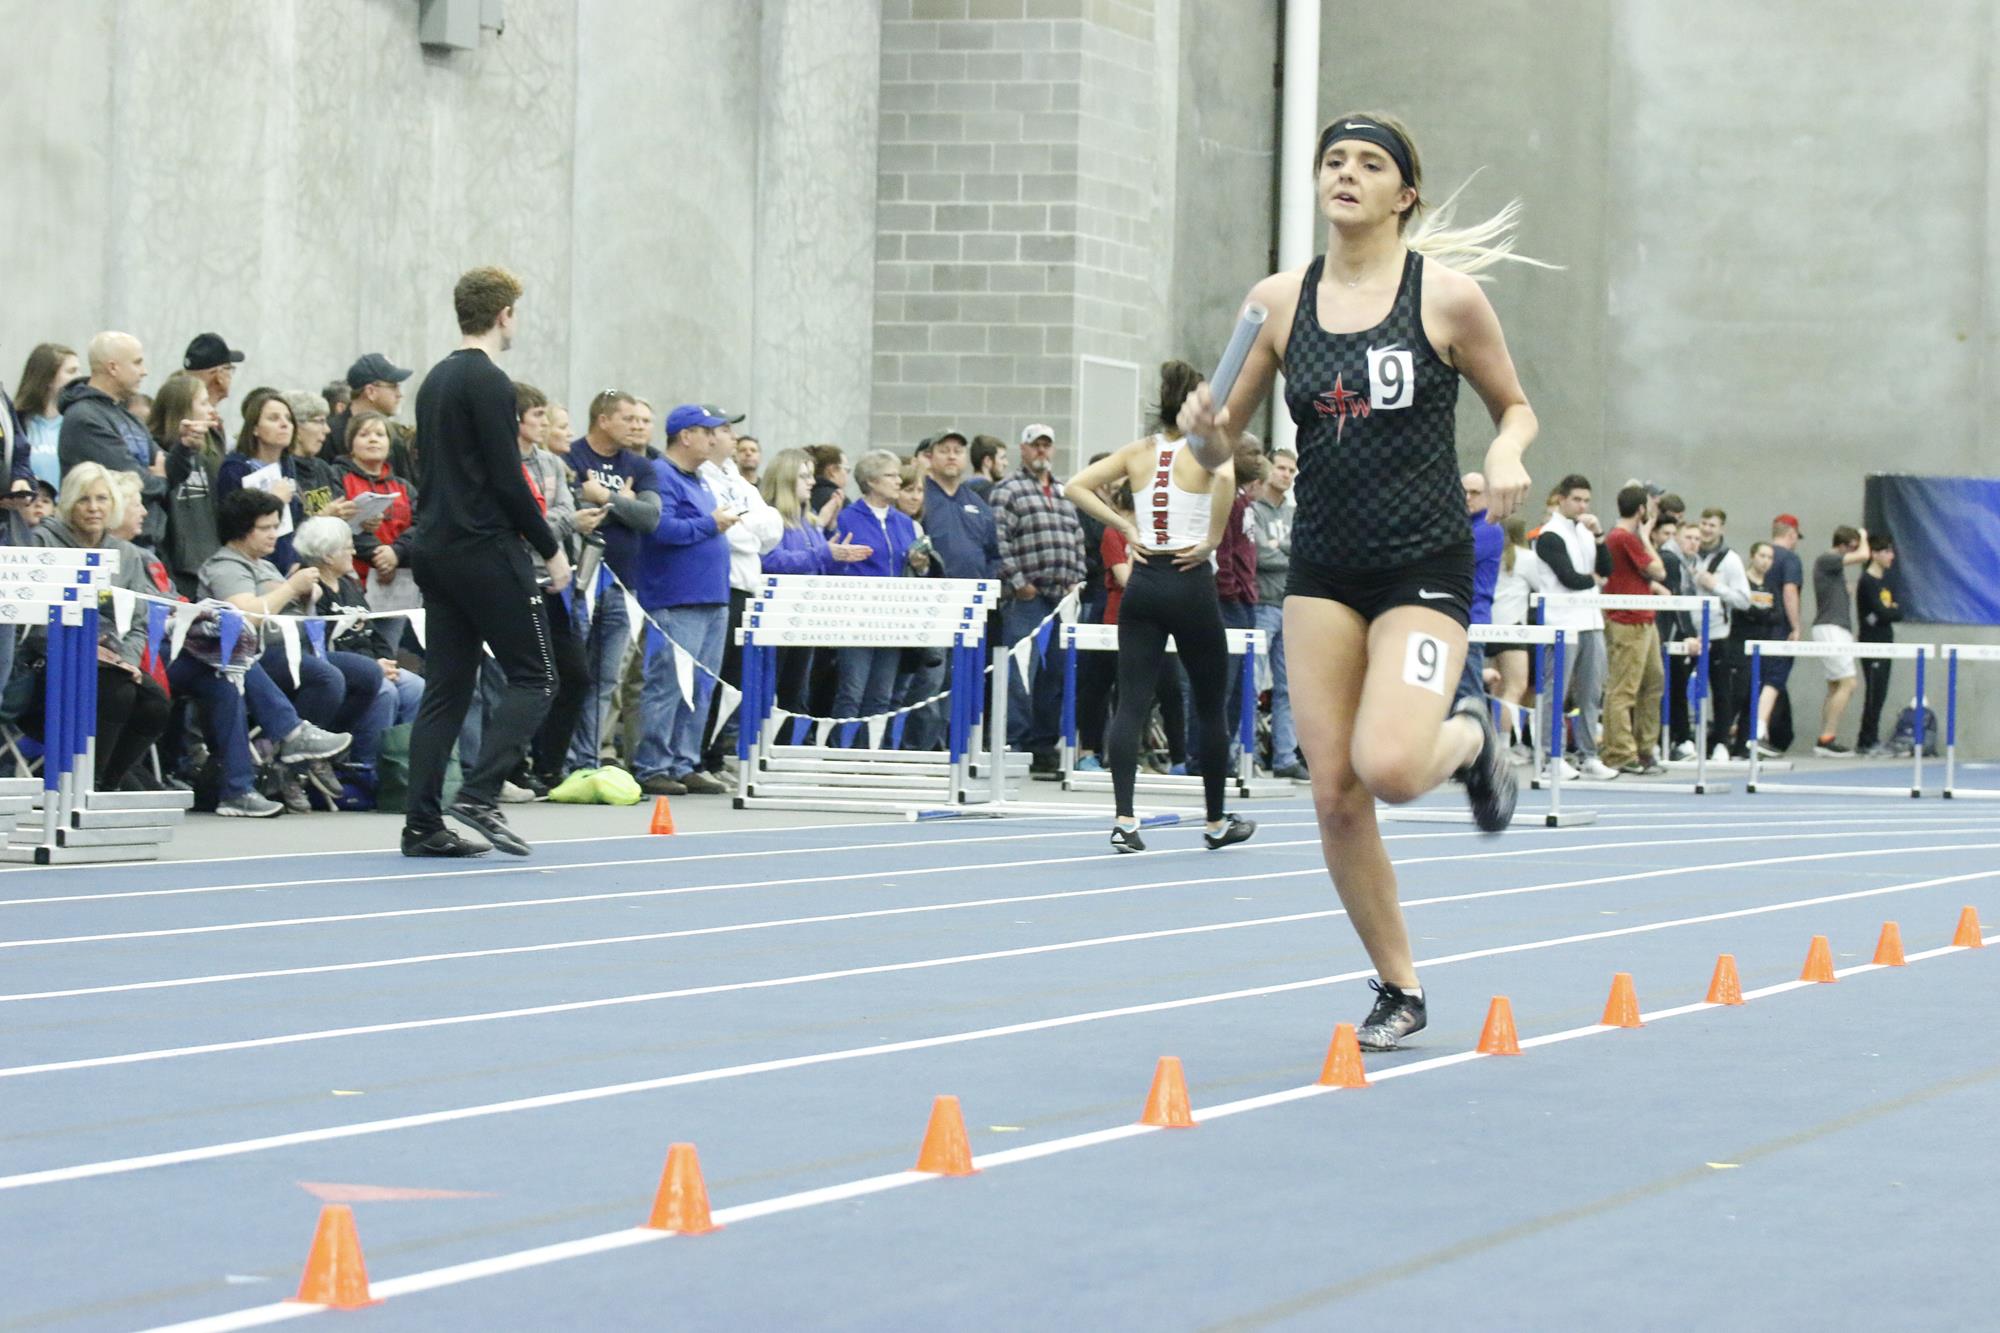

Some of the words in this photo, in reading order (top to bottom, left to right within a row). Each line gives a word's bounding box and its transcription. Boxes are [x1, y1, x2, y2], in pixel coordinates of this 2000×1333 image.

[1378, 354, 1404, 406] 9
[825, 581, 869, 589] DAKOTA
[877, 582, 933, 590] WESLEYAN
[821, 593, 864, 601] DAKOTA
[872, 594, 928, 602] WESLEYAN
[812, 605, 855, 613] DAKOTA
[863, 606, 919, 614] WESLEYAN
[808, 619, 851, 627] DAKOTA
[859, 621, 915, 629] WESLEYAN
[802, 633, 845, 641] DAKOTA
[853, 633, 909, 641] WESLEYAN
[1417, 638, 1438, 682] 9
